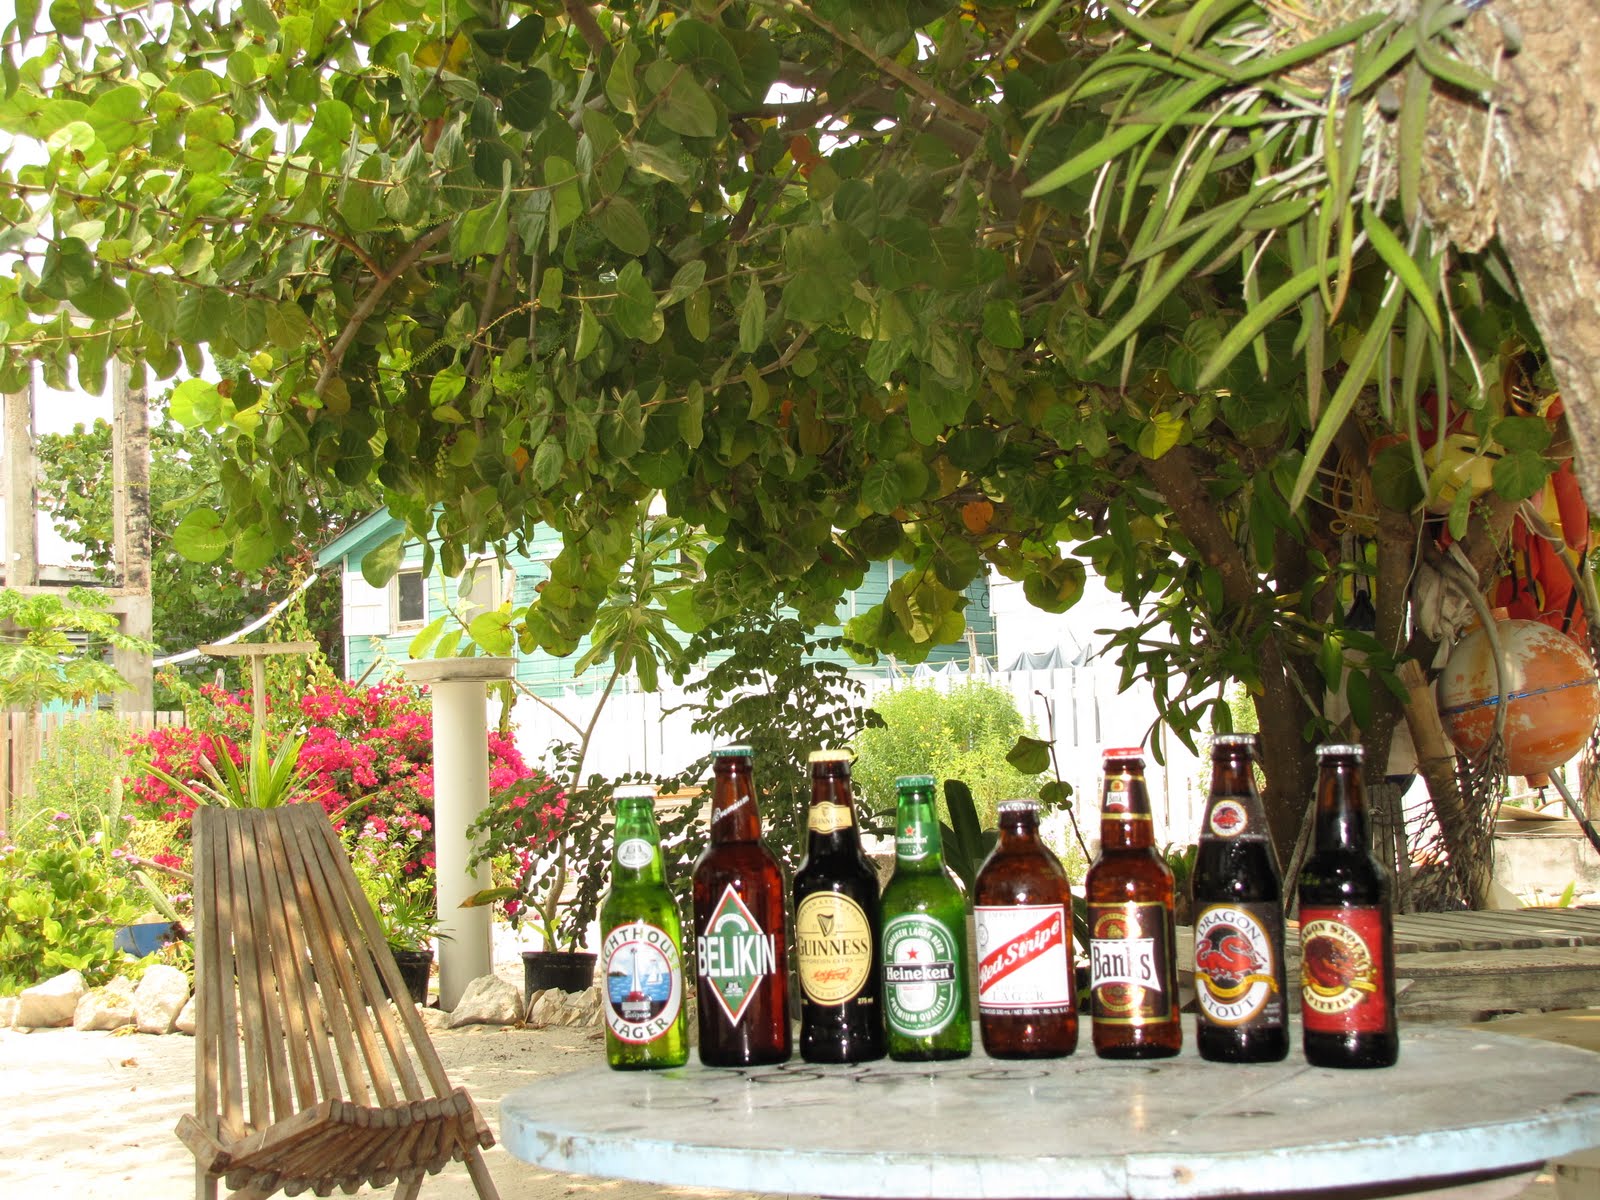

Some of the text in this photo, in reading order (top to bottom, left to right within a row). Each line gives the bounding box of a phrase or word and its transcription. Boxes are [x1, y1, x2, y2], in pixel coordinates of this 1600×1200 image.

[1198, 911, 1261, 940] DRAGON
[602, 928, 680, 971] IGHTHOUSE
[697, 934, 777, 977] BELIKIN
[798, 936, 868, 956] GUINNESS
[887, 928, 909, 956] HEINEKEN
[980, 920, 1060, 989] Red Stripe
[886, 965, 950, 981] Heineken
[890, 995, 947, 1023] PREMIUM QUALITY
[991, 991, 1045, 1001] LAGR
[1203, 993, 1254, 1018] STOUT
[612, 1018, 668, 1039] LAGER
